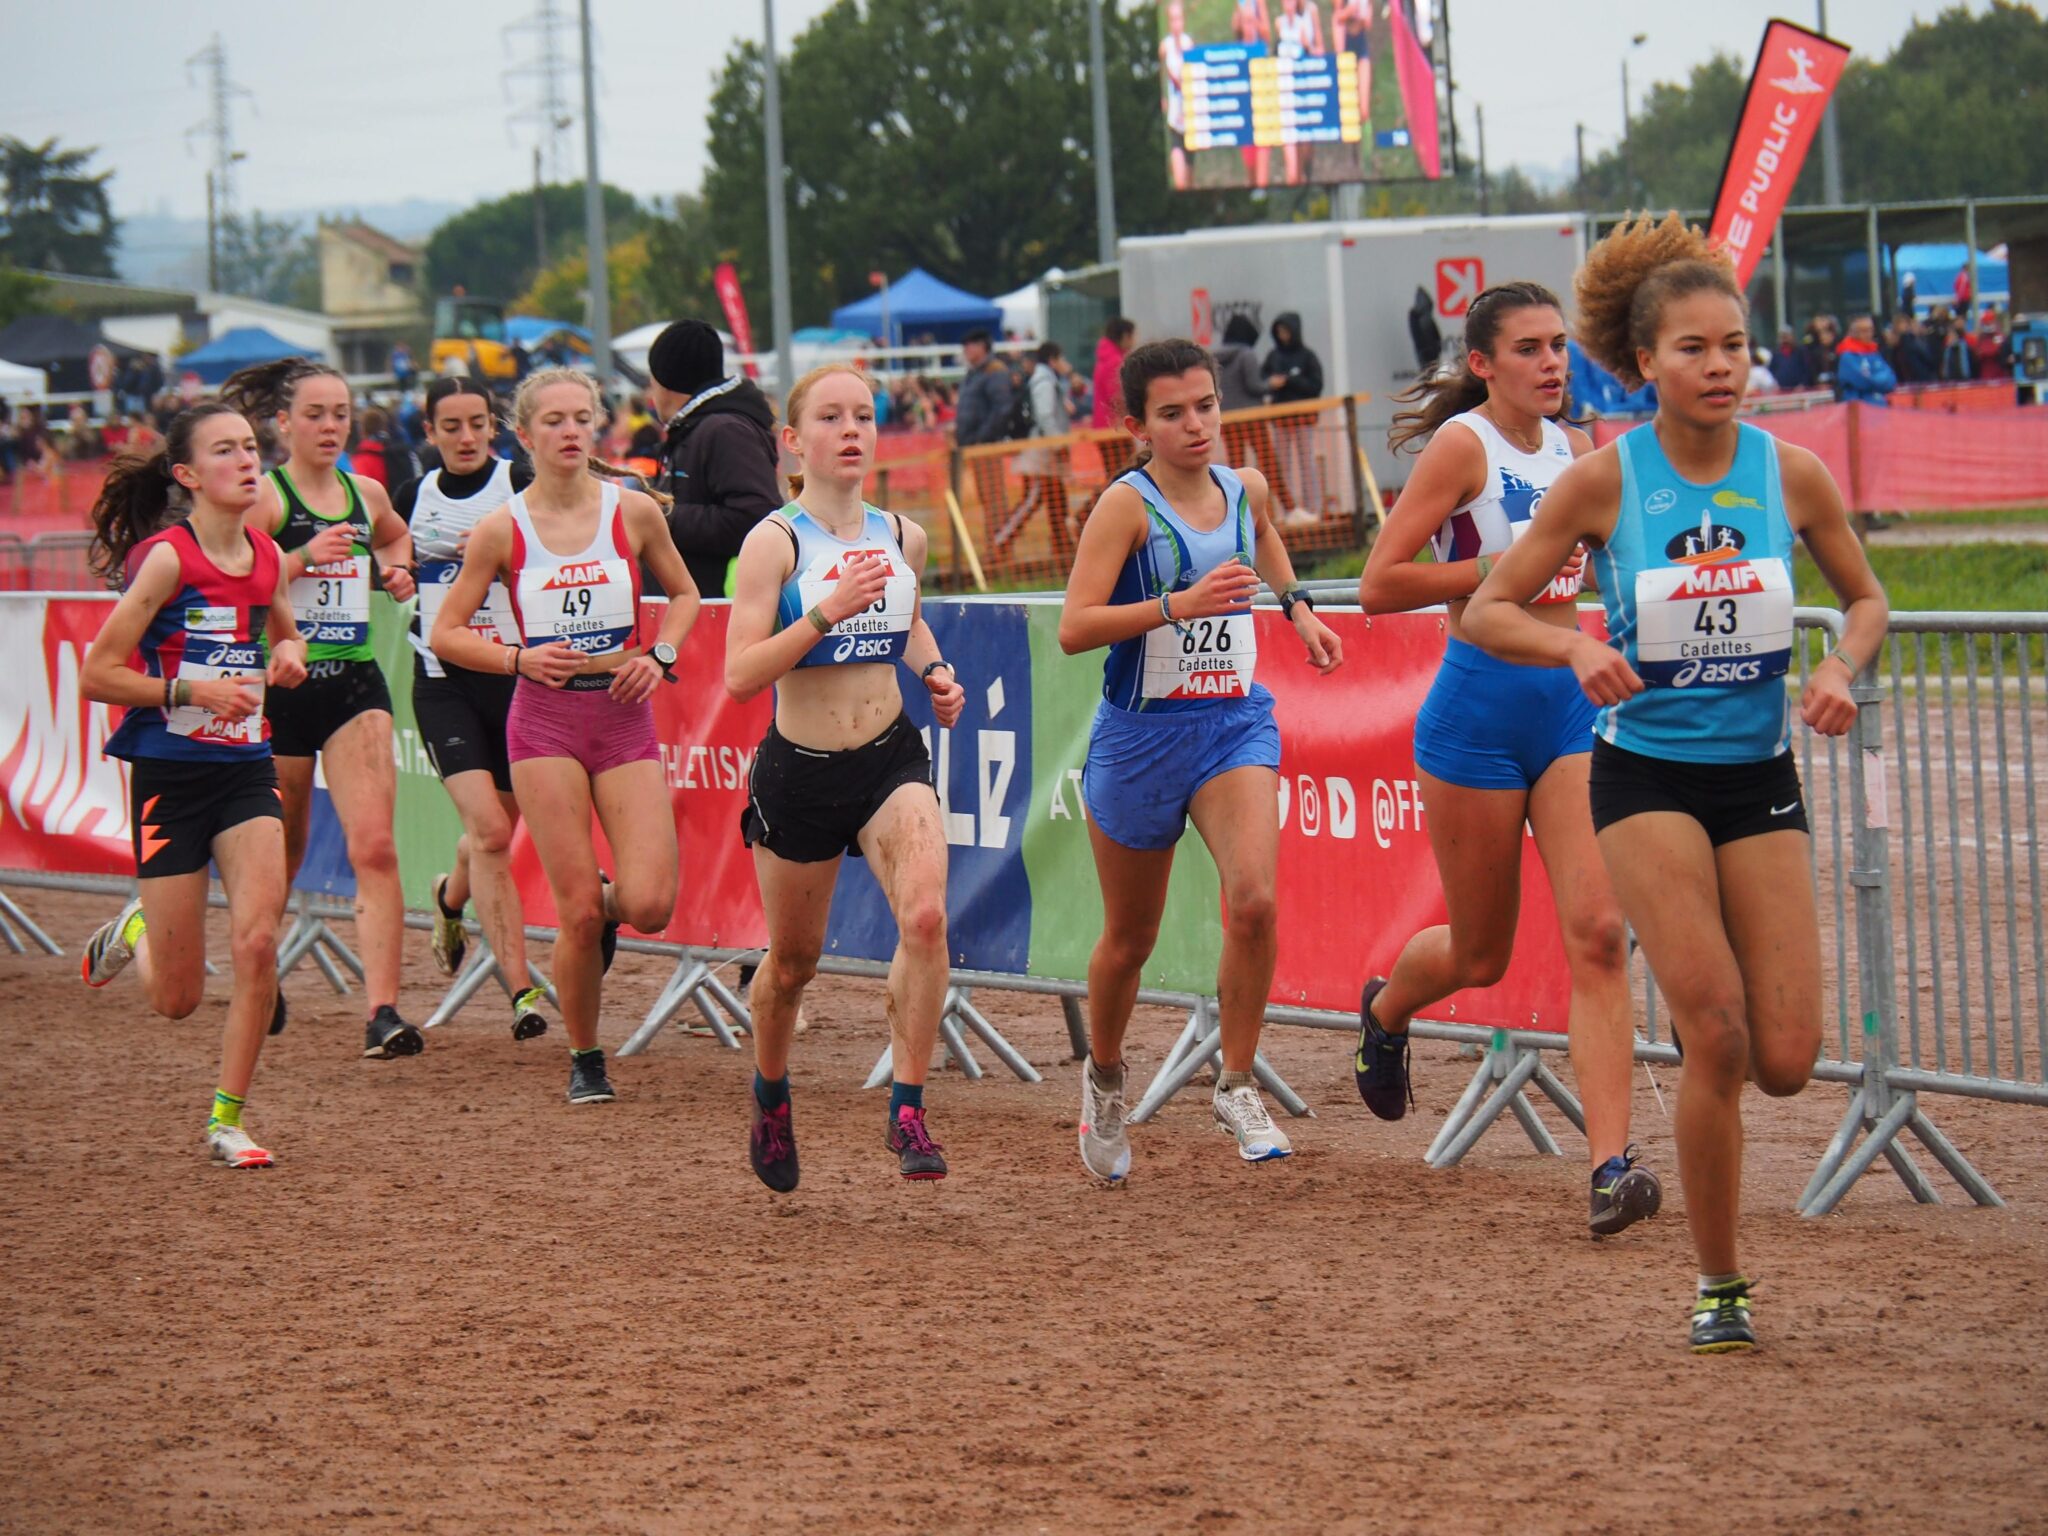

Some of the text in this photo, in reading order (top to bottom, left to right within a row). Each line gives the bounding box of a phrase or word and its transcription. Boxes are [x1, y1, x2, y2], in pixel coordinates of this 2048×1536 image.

[1739, 101, 1798, 213] PUBLIC
[553, 564, 605, 586] MAIF
[1685, 568, 1757, 595] MAIF
[317, 580, 343, 607] 31
[562, 588, 592, 617] 49
[305, 609, 352, 621] Cadettes
[1693, 598, 1738, 636] 43
[318, 626, 357, 641] asics
[553, 620, 605, 634] Cadettes
[837, 619, 889, 634] Cadettes
[570, 634, 612, 651] asics
[1182, 619, 1232, 655] 626
[225, 649, 257, 665] asics
[855, 638, 893, 657] asics
[1680, 641, 1752, 658] Cadettes
[1178, 658, 1234, 672] Cadettes
[1701, 660, 1761, 683] asics
[574, 678, 609, 688] Reebo
[1182, 674, 1240, 696] MAIF
